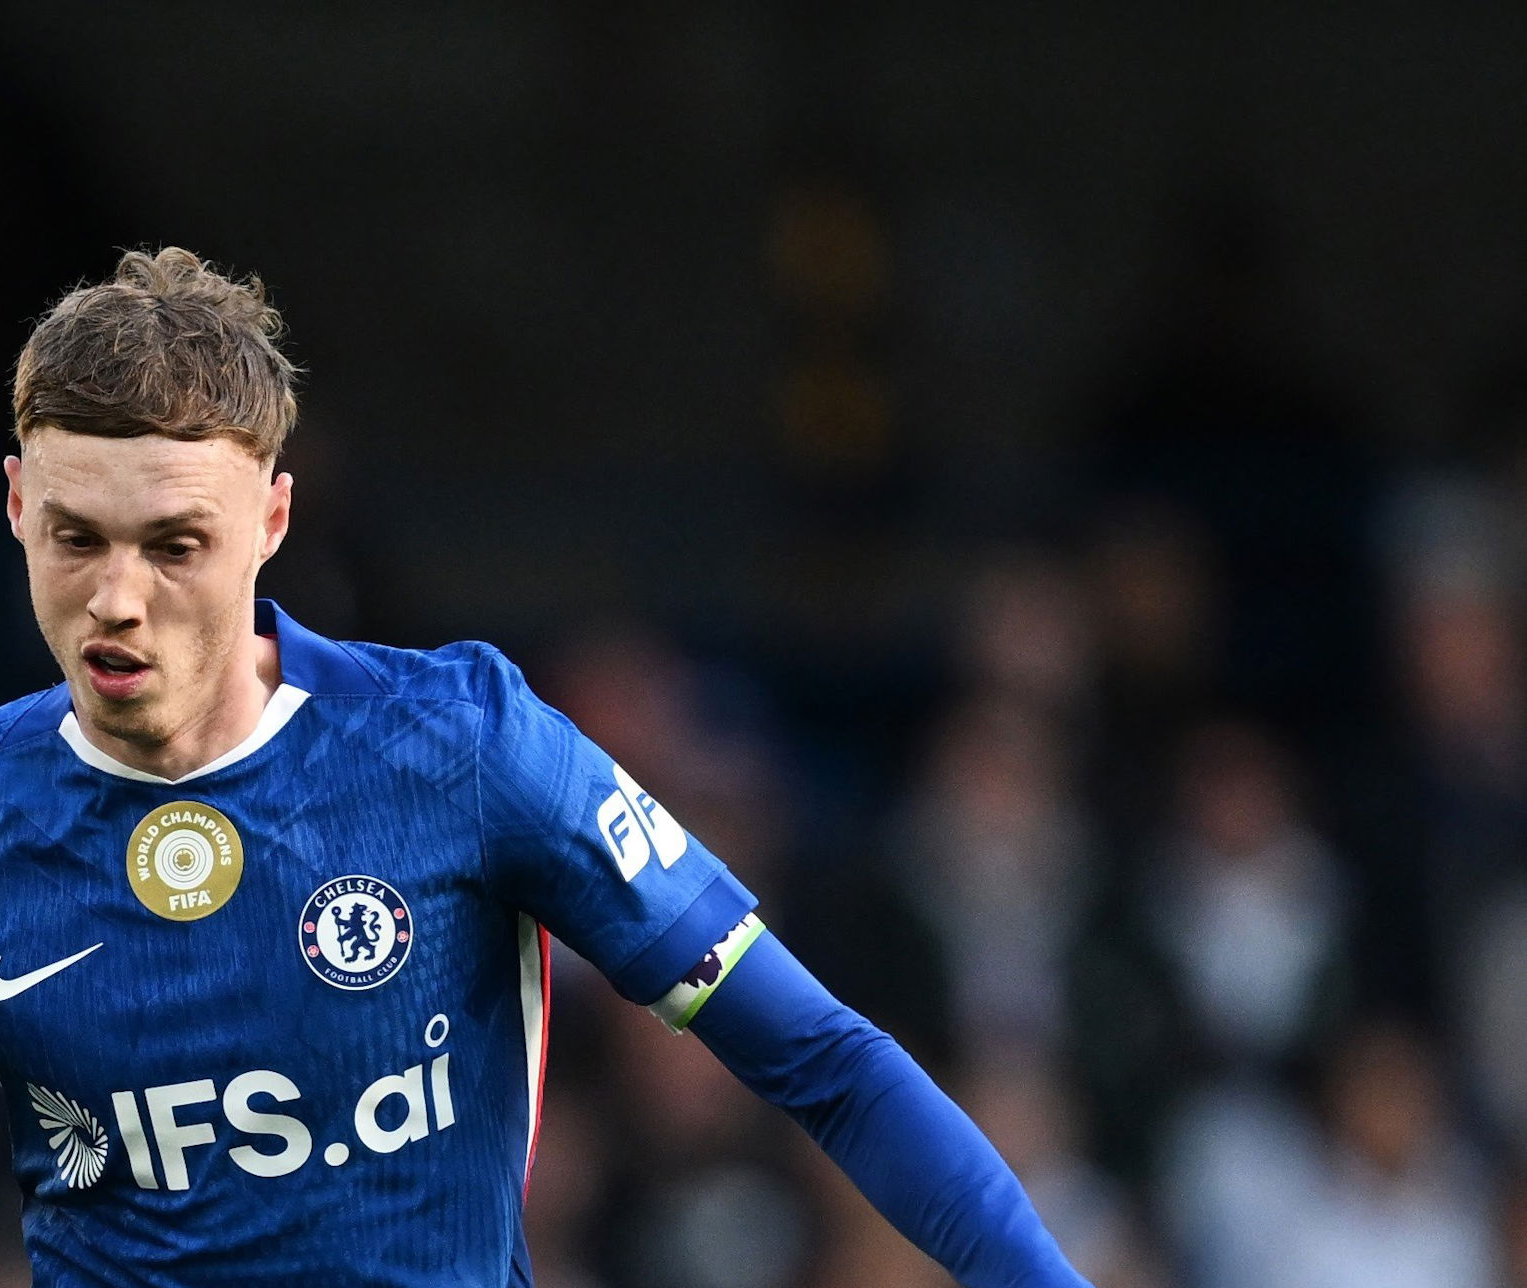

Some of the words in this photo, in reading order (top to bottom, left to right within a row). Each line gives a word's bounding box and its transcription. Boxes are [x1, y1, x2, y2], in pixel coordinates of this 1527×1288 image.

[136, 824, 160, 882] WORLD
[160, 811, 232, 866] CHAMPIONS
[168, 889, 213, 912] FIFA
[314, 879, 386, 908] CHELSEA
[324, 967, 374, 984] FOOTBALL
[377, 956, 399, 977] CLUB
[111, 1012, 456, 1192] IFS.ai
